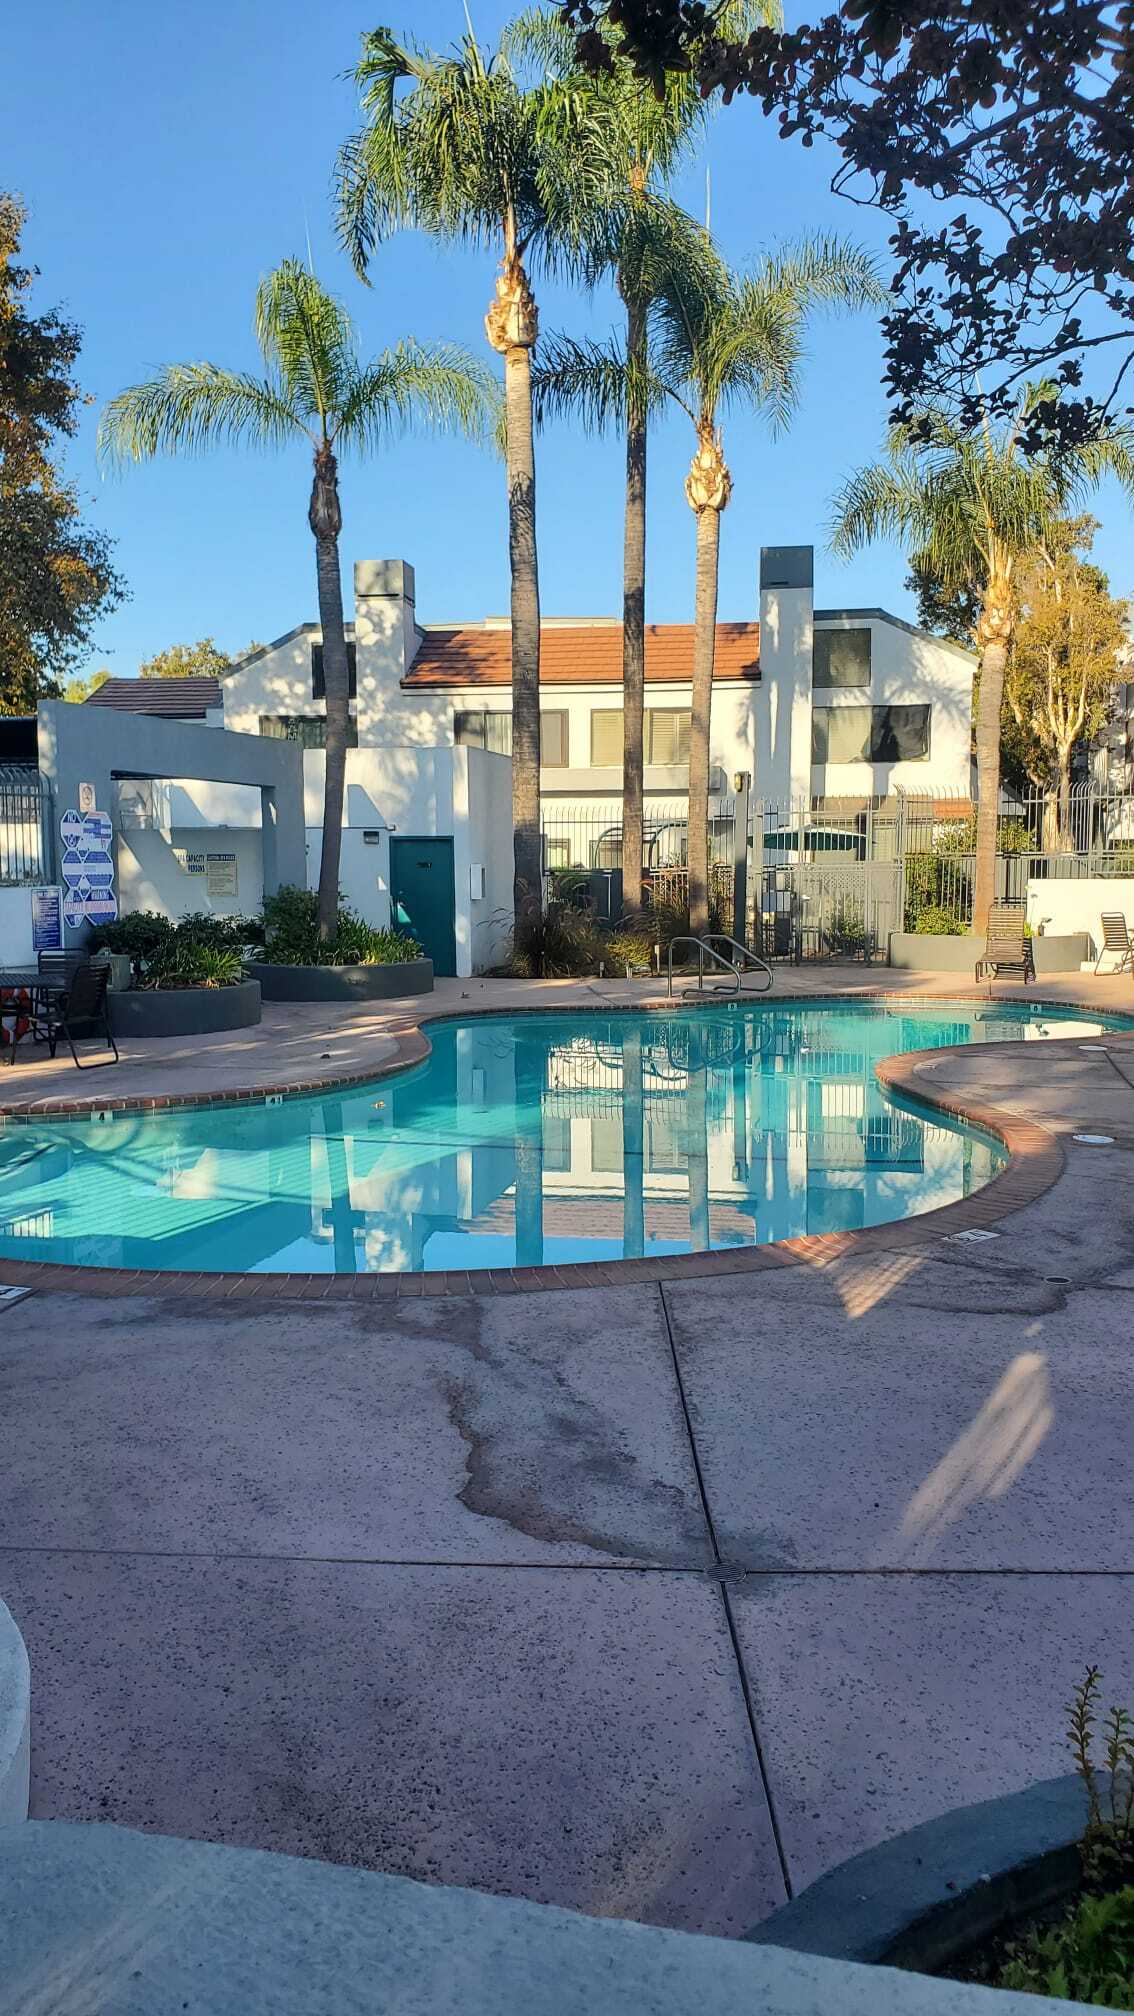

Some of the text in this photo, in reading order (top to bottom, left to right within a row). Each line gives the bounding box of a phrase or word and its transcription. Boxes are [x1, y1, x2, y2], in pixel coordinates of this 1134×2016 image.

[67, 812, 76, 823] NO
[186, 853, 205, 863] CAPACITY
[188, 863, 205, 873] PERSONS
